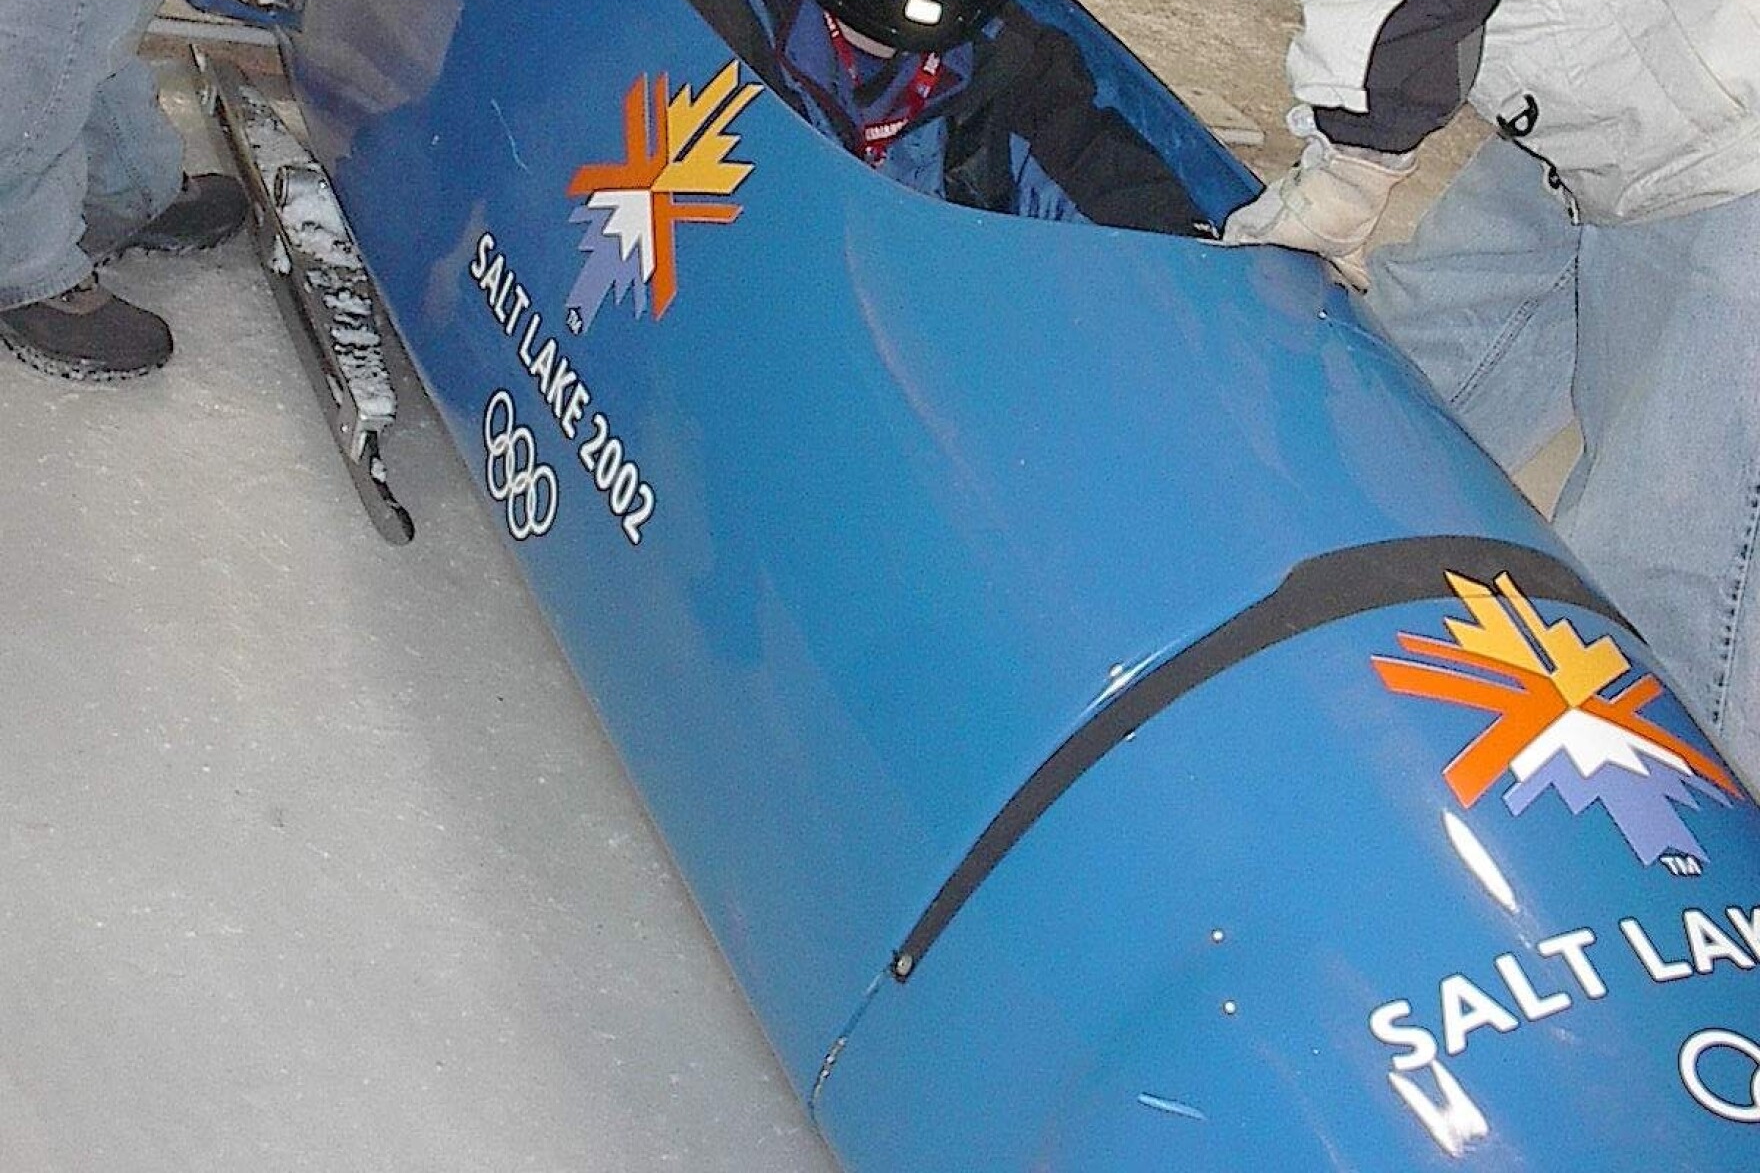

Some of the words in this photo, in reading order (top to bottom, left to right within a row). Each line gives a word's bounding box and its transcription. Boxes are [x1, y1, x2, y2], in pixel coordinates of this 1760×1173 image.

[470, 232, 531, 336] SALT
[518, 314, 591, 439] LAKE
[578, 413, 655, 544] 2002
[1368, 927, 1607, 1071] SALT
